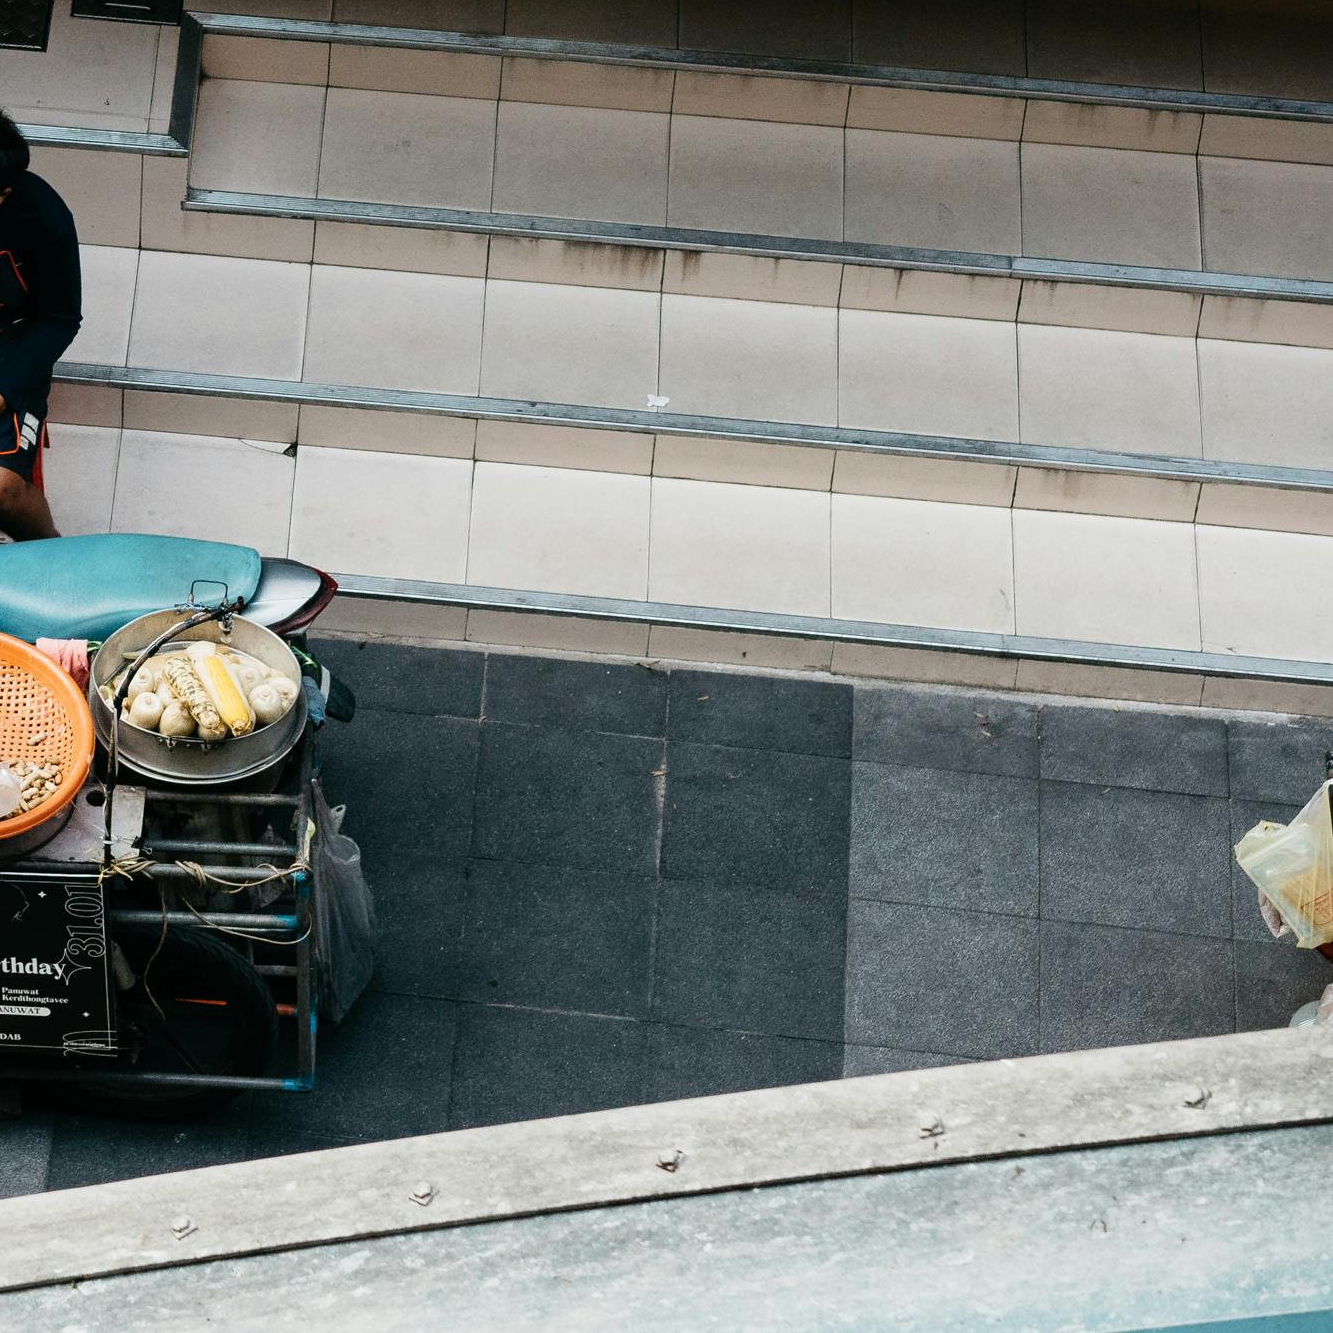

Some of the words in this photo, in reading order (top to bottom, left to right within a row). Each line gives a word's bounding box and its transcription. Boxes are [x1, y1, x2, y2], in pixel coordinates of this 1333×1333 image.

[64, 883, 106, 958] 31.01
[2, 987, 39, 995] Panuwat
[2, 994, 69, 1004] Kerdthongtavee
